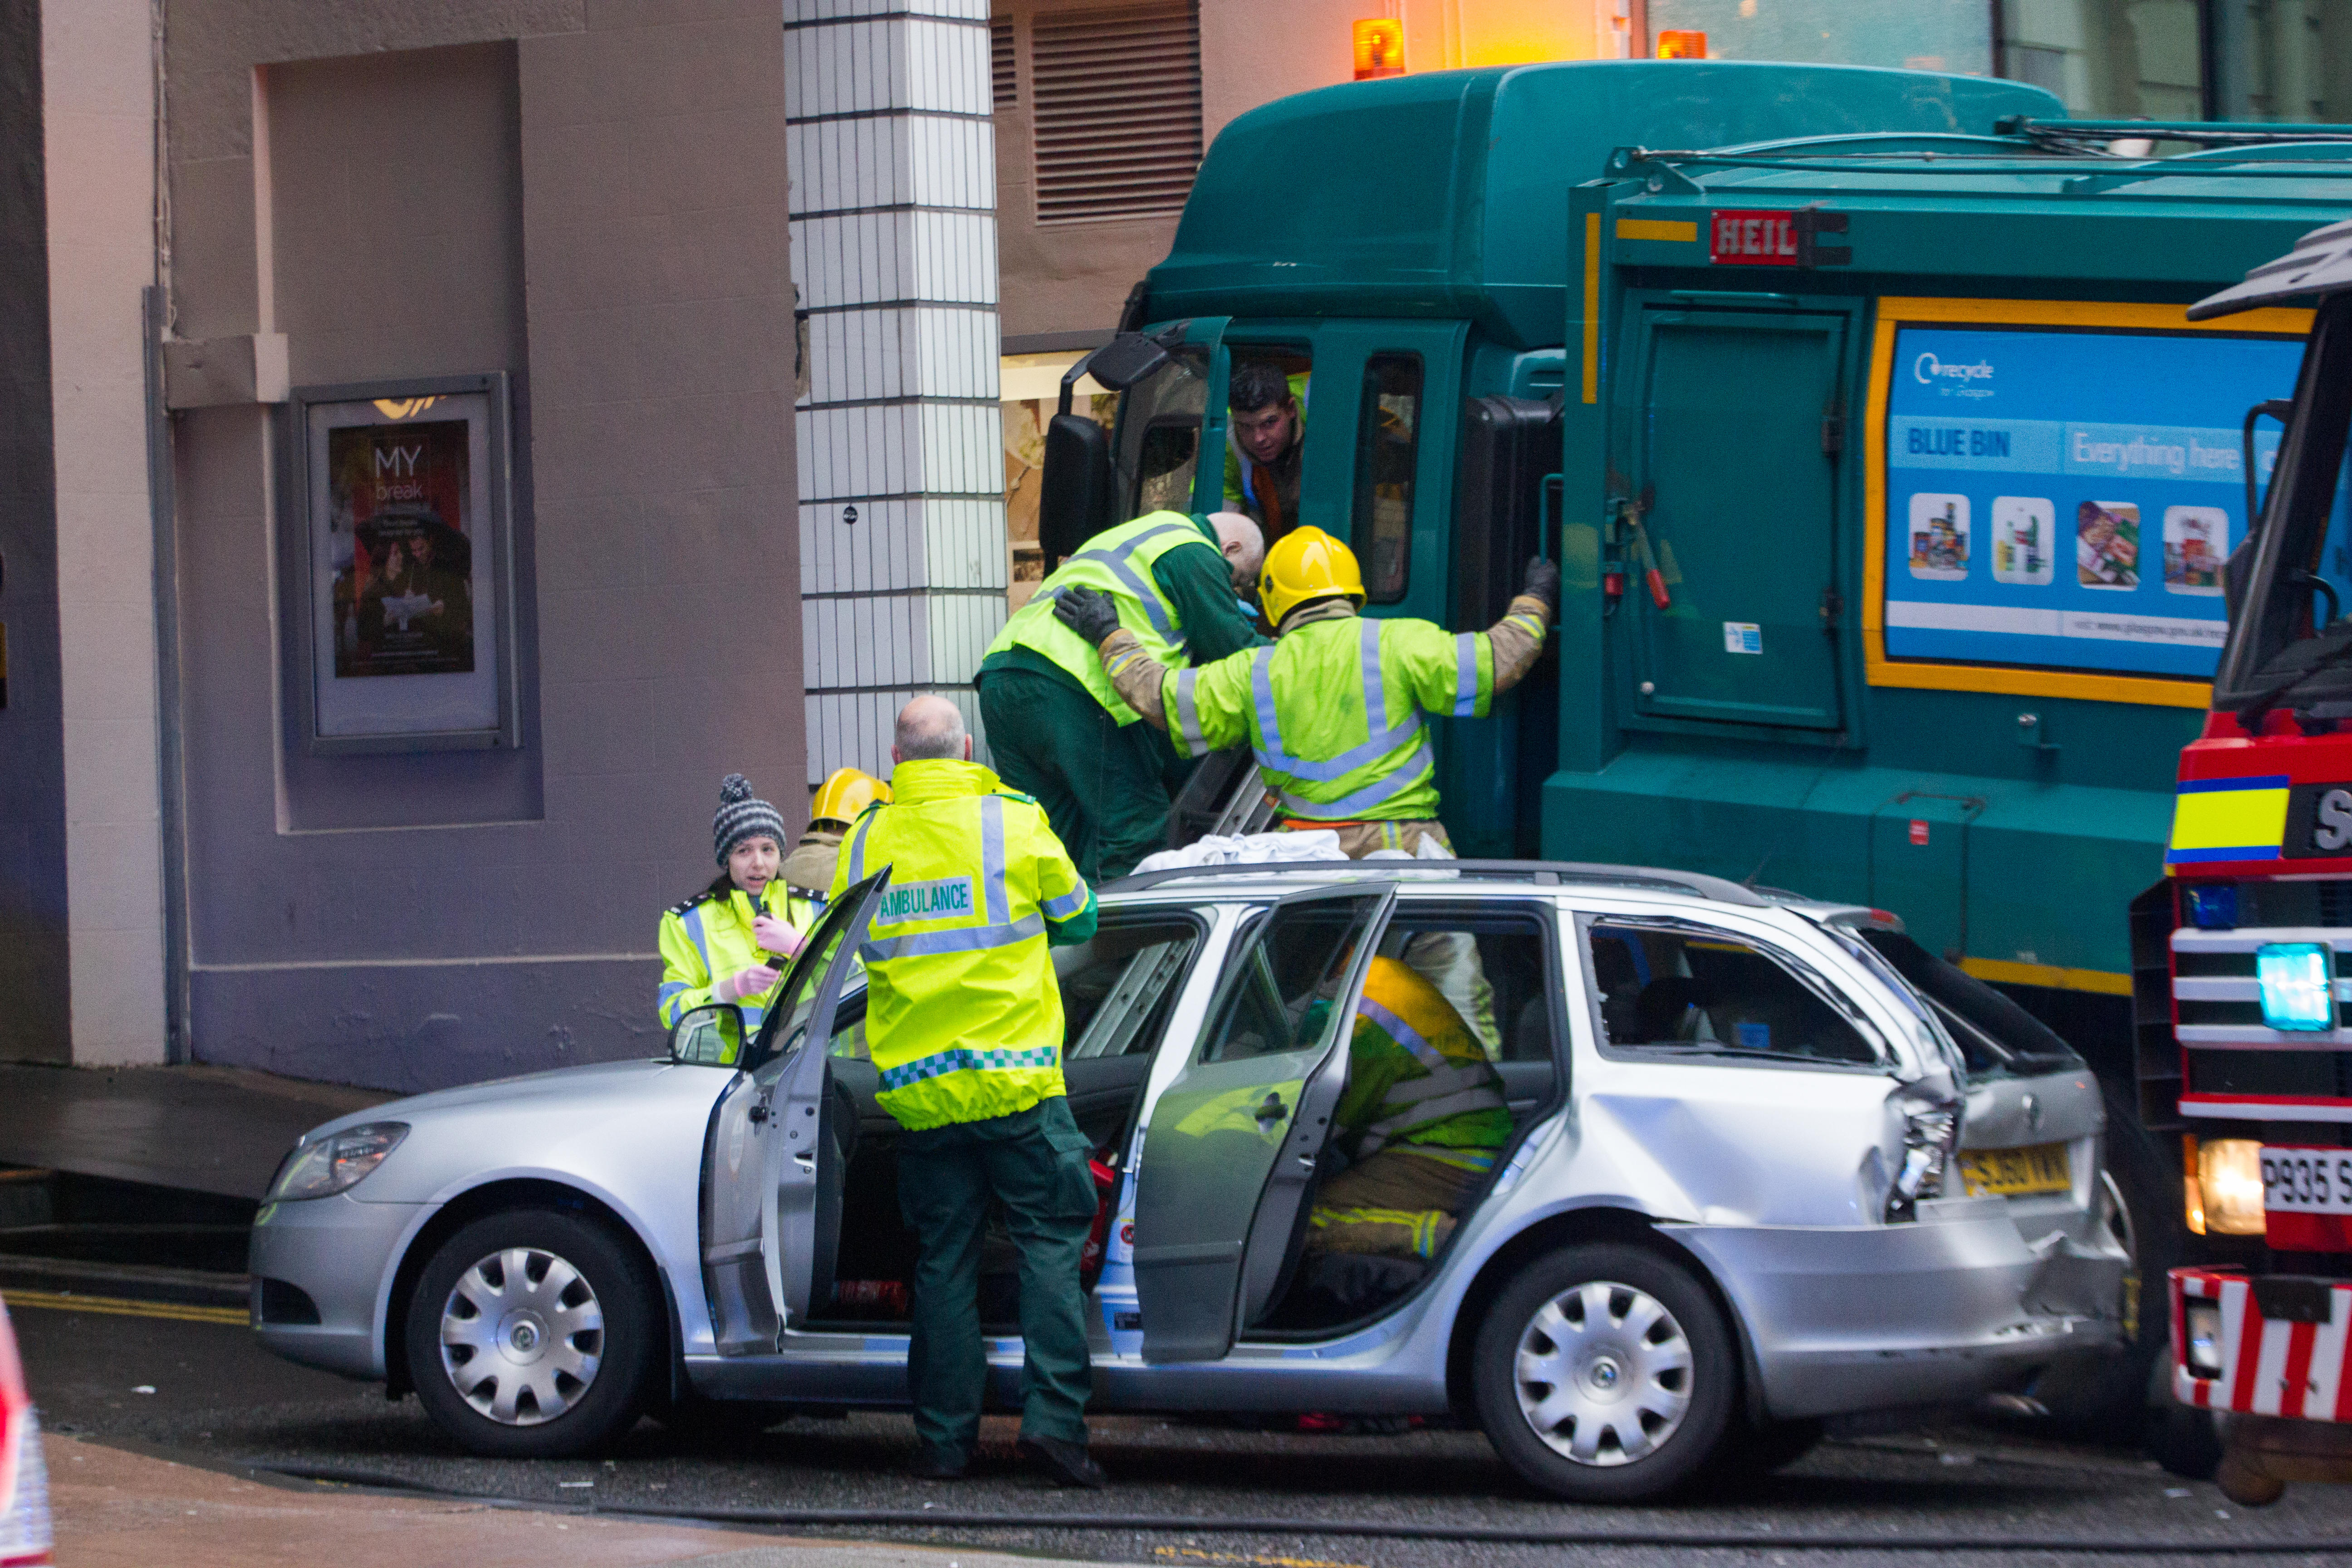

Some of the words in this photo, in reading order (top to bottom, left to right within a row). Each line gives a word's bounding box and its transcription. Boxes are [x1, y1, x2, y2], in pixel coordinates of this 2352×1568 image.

[1718, 219, 1797, 255] HEIL
[1908, 428, 1966, 456] BLUE
[1970, 430, 2011, 457] BIN
[2073, 432, 2185, 474] Everything
[2190, 438, 2240, 470] here
[375, 446, 422, 477] MY
[376, 479, 424, 500] break
[880, 884, 969, 918] AMBULANCE
[2261, 1158, 2331, 1205] P935
